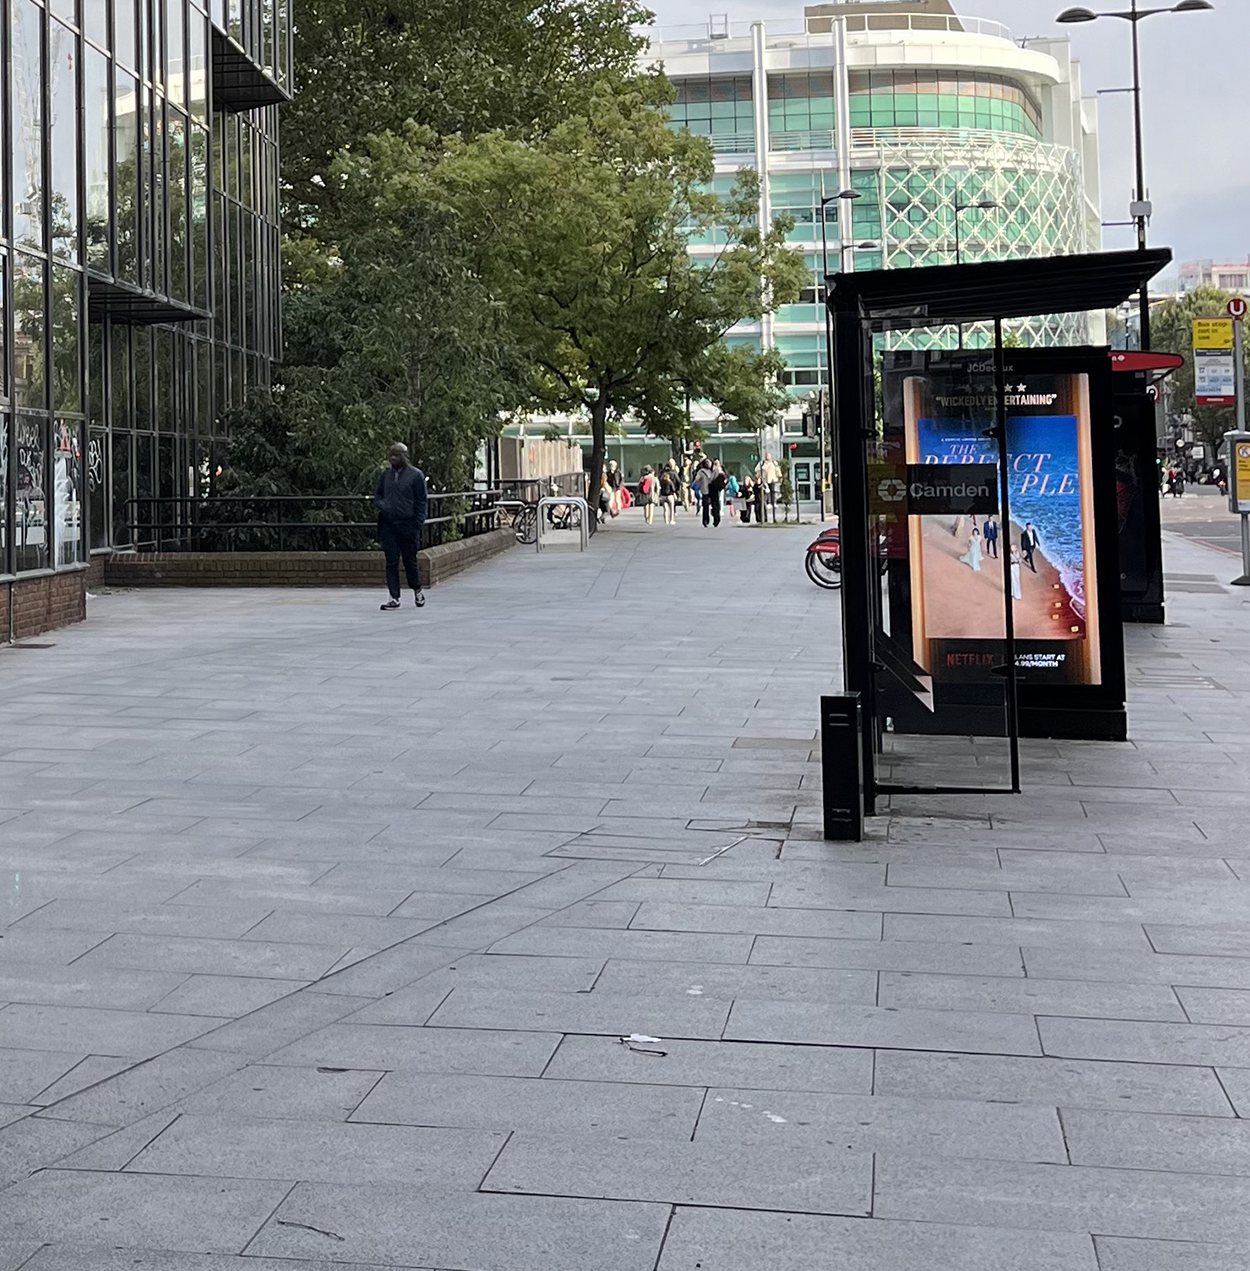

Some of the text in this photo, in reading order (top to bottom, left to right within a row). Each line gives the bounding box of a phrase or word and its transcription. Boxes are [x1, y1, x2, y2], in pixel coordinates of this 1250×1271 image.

[1230, 301, 1244, 316] U
[967, 363, 1014, 373] JCDecux
[988, 393, 1058, 406] ENERTAINING”
[950, 444, 979, 455] THE
[910, 482, 990, 498] Camden
[946, 653, 994, 666] NETFLIX
